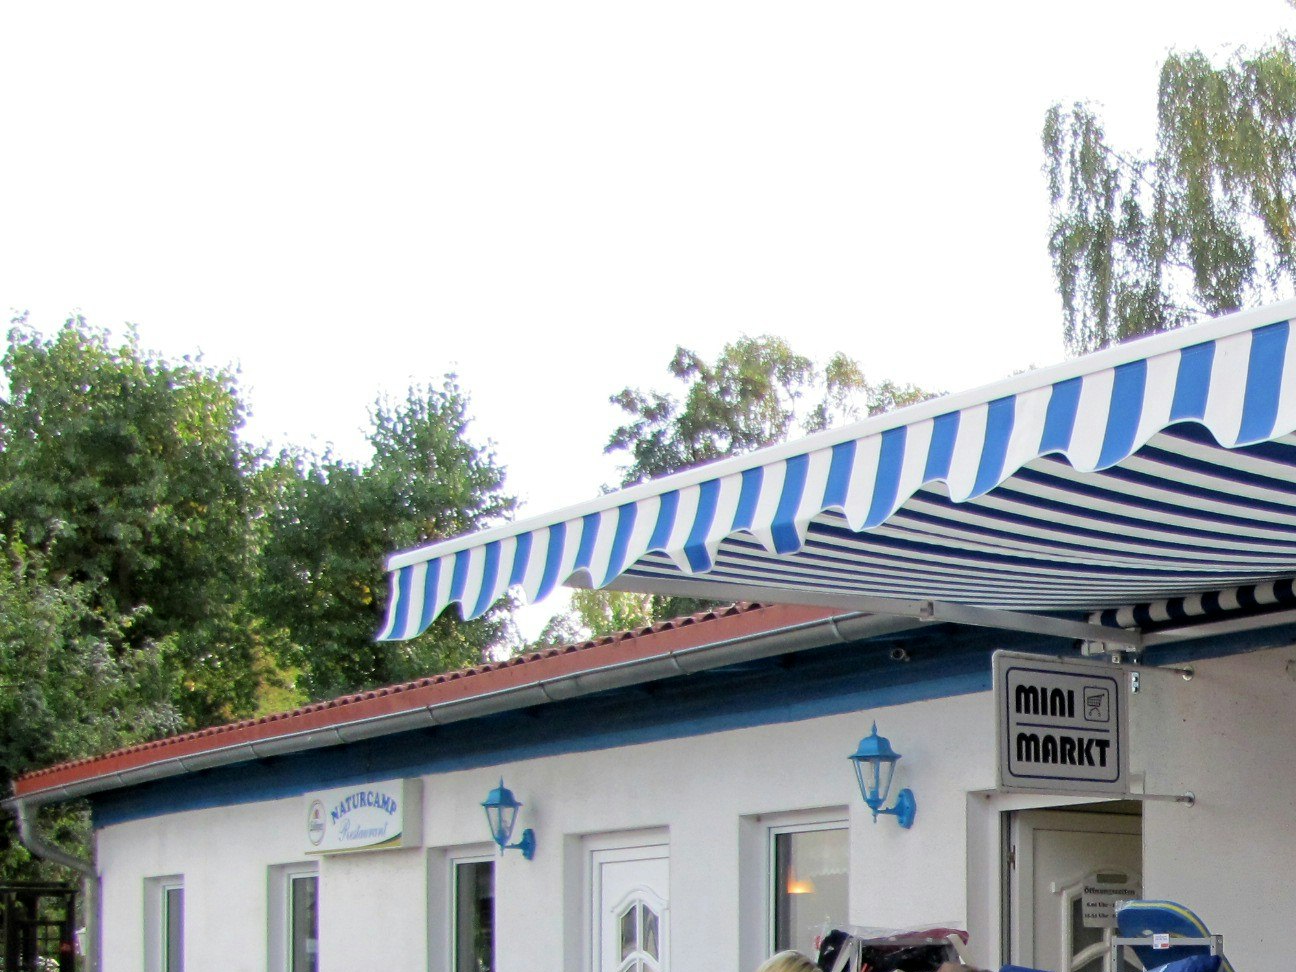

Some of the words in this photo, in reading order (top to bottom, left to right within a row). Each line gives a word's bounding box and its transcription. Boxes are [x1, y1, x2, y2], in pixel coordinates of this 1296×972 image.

[1015, 684, 1075, 718] MINI
[1016, 732, 1110, 767] MARKT
[330, 790, 397, 825] NATURCAMP
[338, 818, 388, 842] Restaurant
